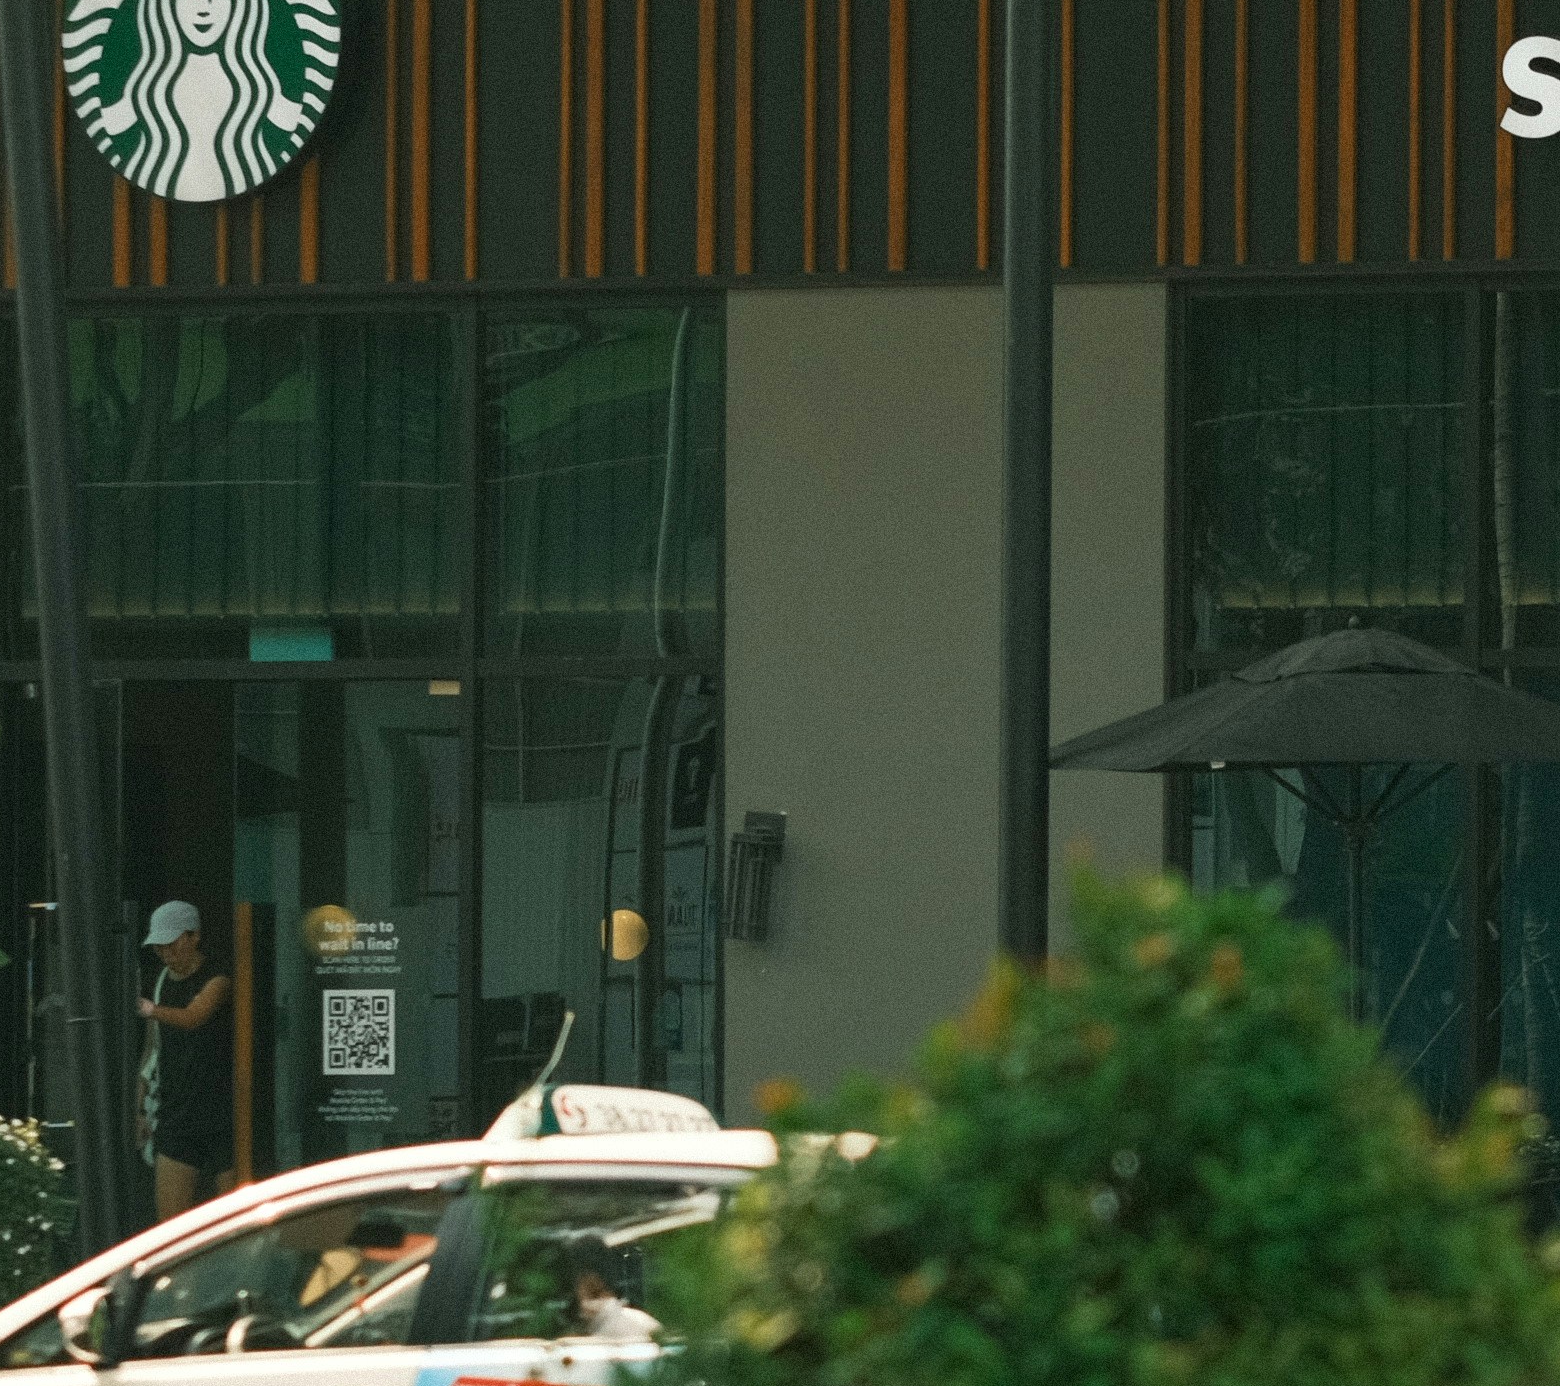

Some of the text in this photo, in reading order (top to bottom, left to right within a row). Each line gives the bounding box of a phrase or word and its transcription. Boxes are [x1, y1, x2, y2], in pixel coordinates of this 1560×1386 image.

[323, 920, 343, 933] No
[379, 921, 395, 933] to
[351, 937, 365, 951] in
